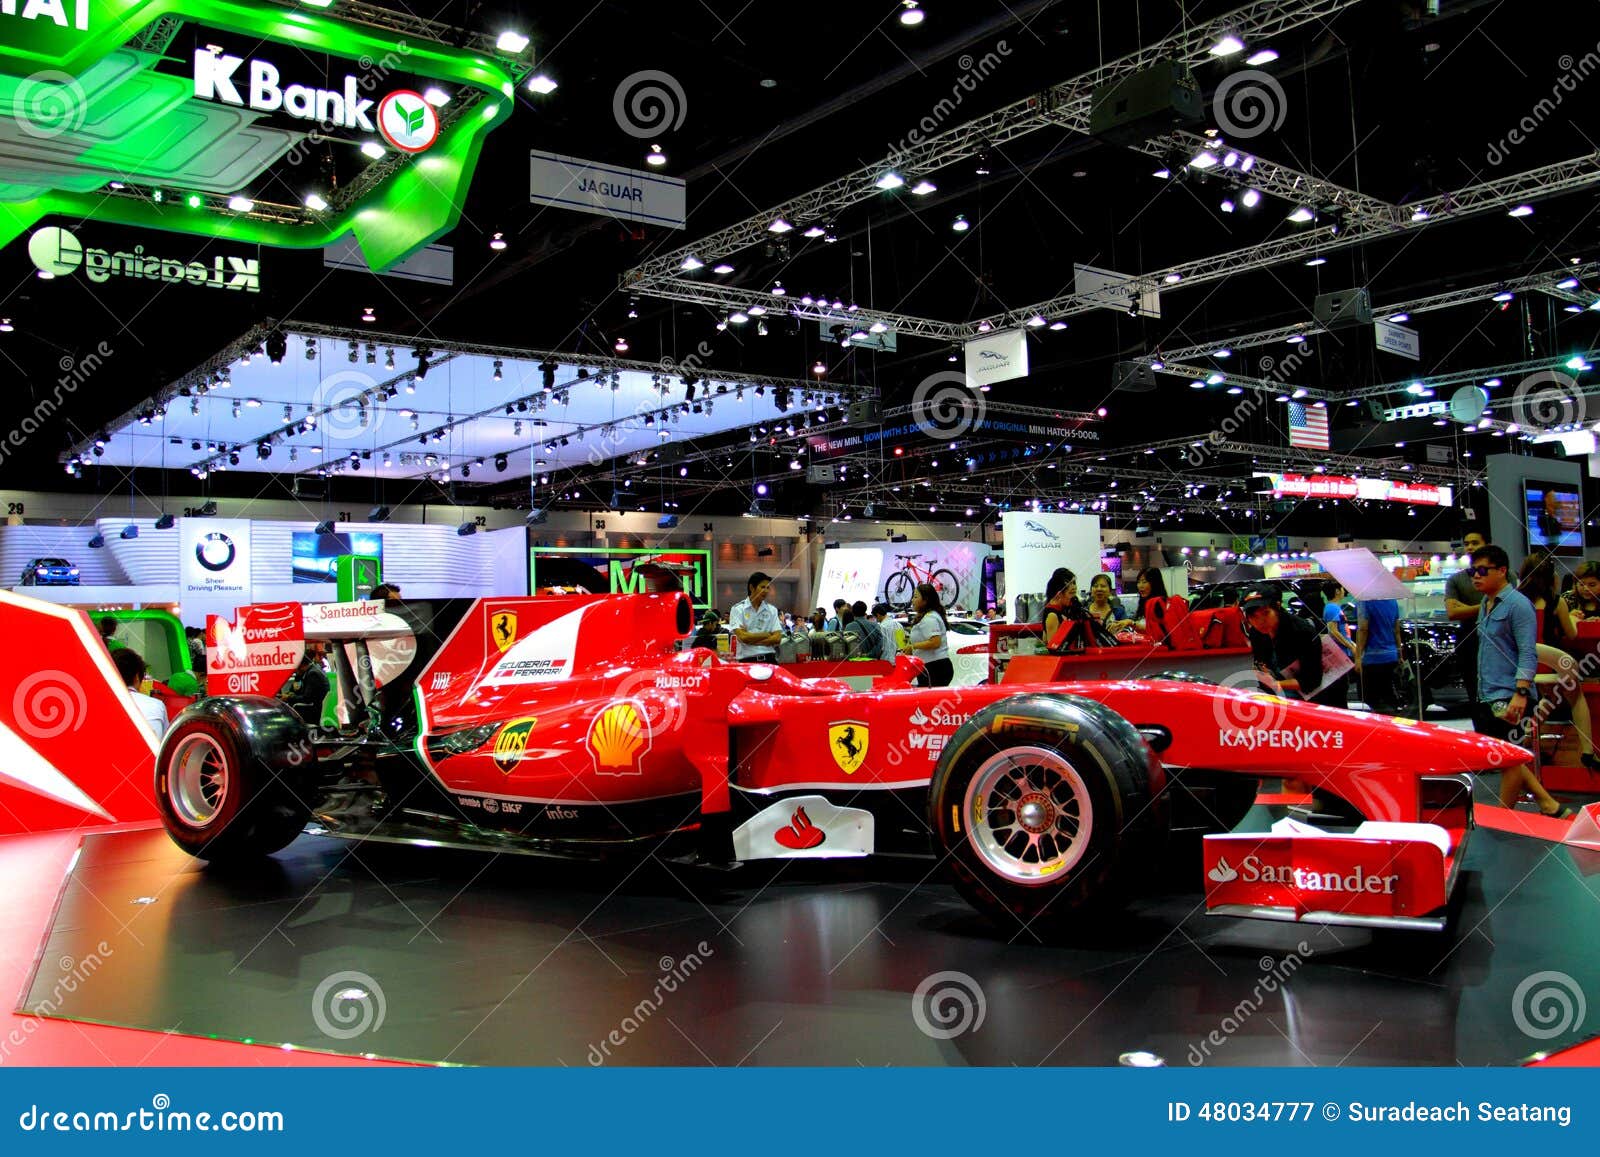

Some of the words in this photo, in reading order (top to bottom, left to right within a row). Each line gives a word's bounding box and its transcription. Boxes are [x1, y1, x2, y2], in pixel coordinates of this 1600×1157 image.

[578, 178, 643, 202] JAGUAR
[992, 421, 1027, 433] ORIGINAL
[1029, 424, 1045, 434] MINI
[1047, 427, 1070, 438] HATCH
[814, 444, 827, 453] THE
[829, 441, 844, 451] NEW
[844, 436, 862, 447] MINI.
[863, 432, 880, 442] NOW
[882, 428, 901, 439] WITH
[8, 502, 25, 515] 29
[339, 511, 351, 522] 31
[475, 516, 486, 527] 32
[595, 519, 606, 531] 33
[188, 584, 213, 592] Driving
[320, 602, 378, 620] Santander
[227, 646, 295, 669] Santander
[498, 659, 550, 670] SCUDERIA
[514, 667, 563, 677] FERRARI
[431, 671, 452, 690] FIAT
[655, 675, 702, 688] HUBLOT
[1219, 726, 1332, 751] KASPERSKY
[496, 730, 527, 763] ups
[501, 802, 522, 814] SKF
[546, 806, 579, 820] infor
[1242, 856, 1399, 894] Santander
